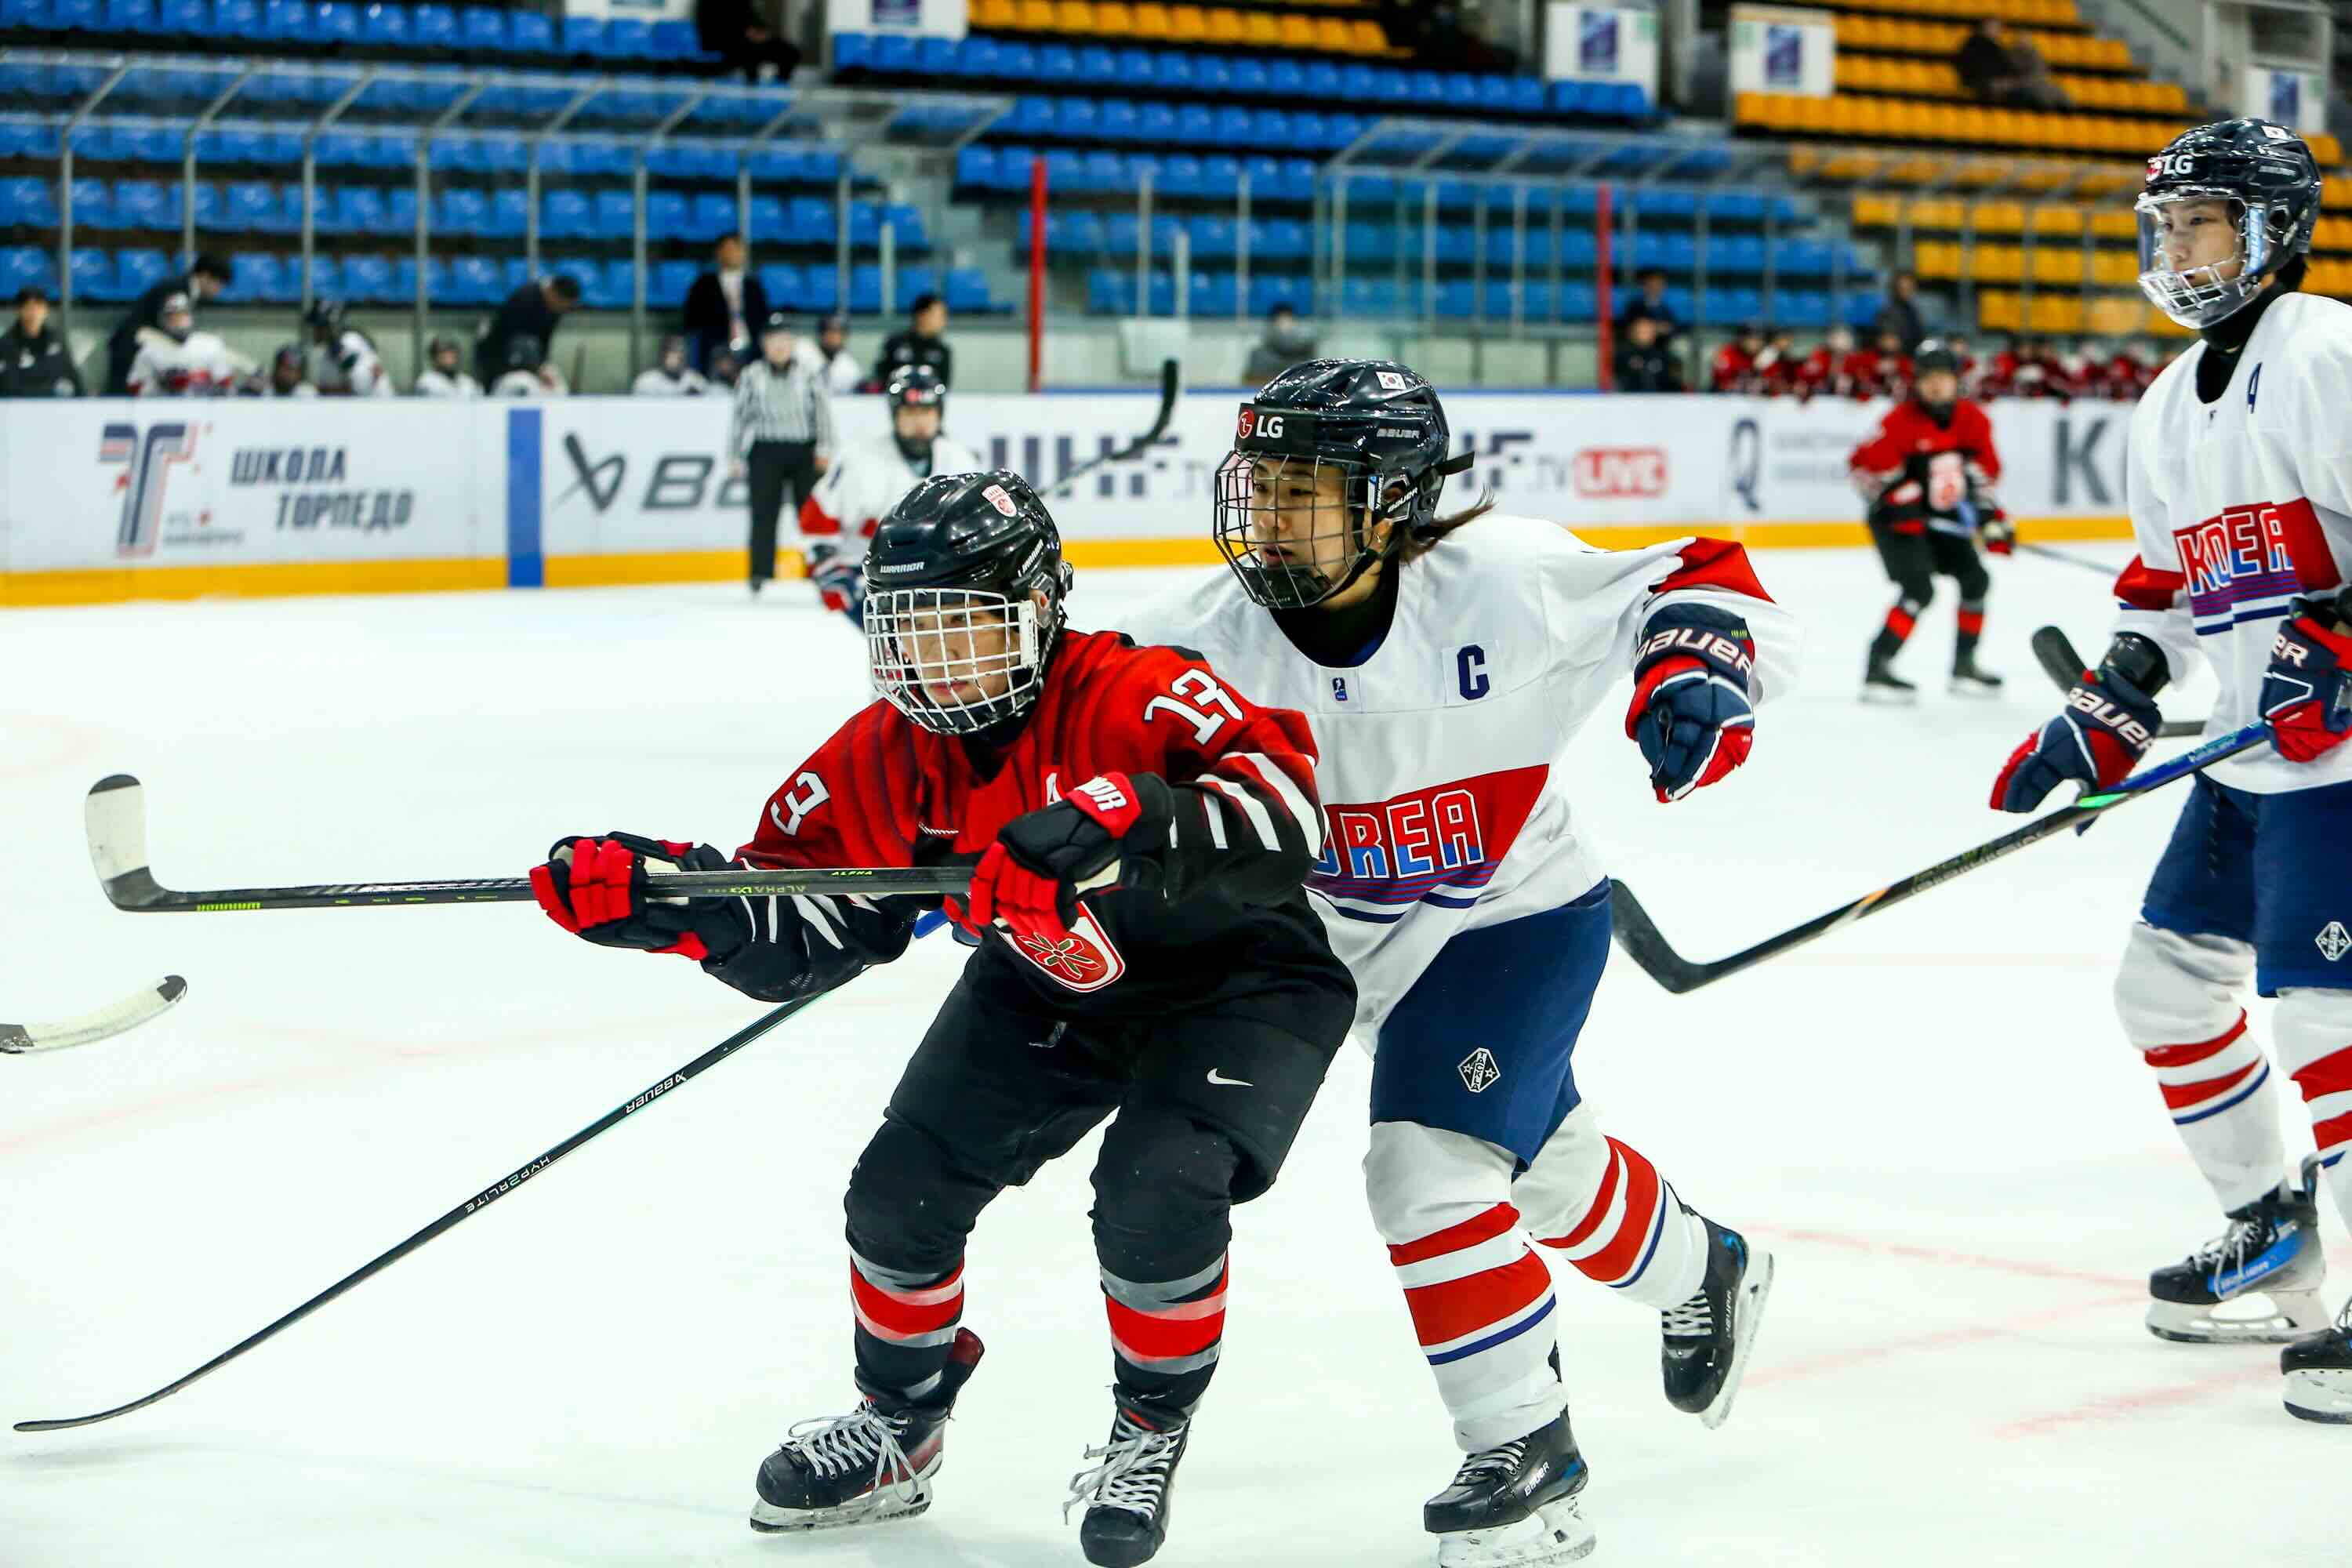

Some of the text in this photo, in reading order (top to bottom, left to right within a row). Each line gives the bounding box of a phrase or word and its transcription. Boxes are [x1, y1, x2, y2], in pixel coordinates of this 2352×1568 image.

[2162, 155, 2193, 175] LG
[1256, 416, 1283, 438] LG
[230, 446, 347, 486] ШКОЛА
[276, 491, 414, 533] ТОРПЕДО
[880, 561, 925, 573] WARRIOR
[2176, 508, 2295, 597] KOEA
[1457, 644, 1490, 701] C
[1144, 667, 1244, 746] 13
[1312, 789, 1484, 878] REA
[1471, 1051, 1488, 1091] TACKLA
